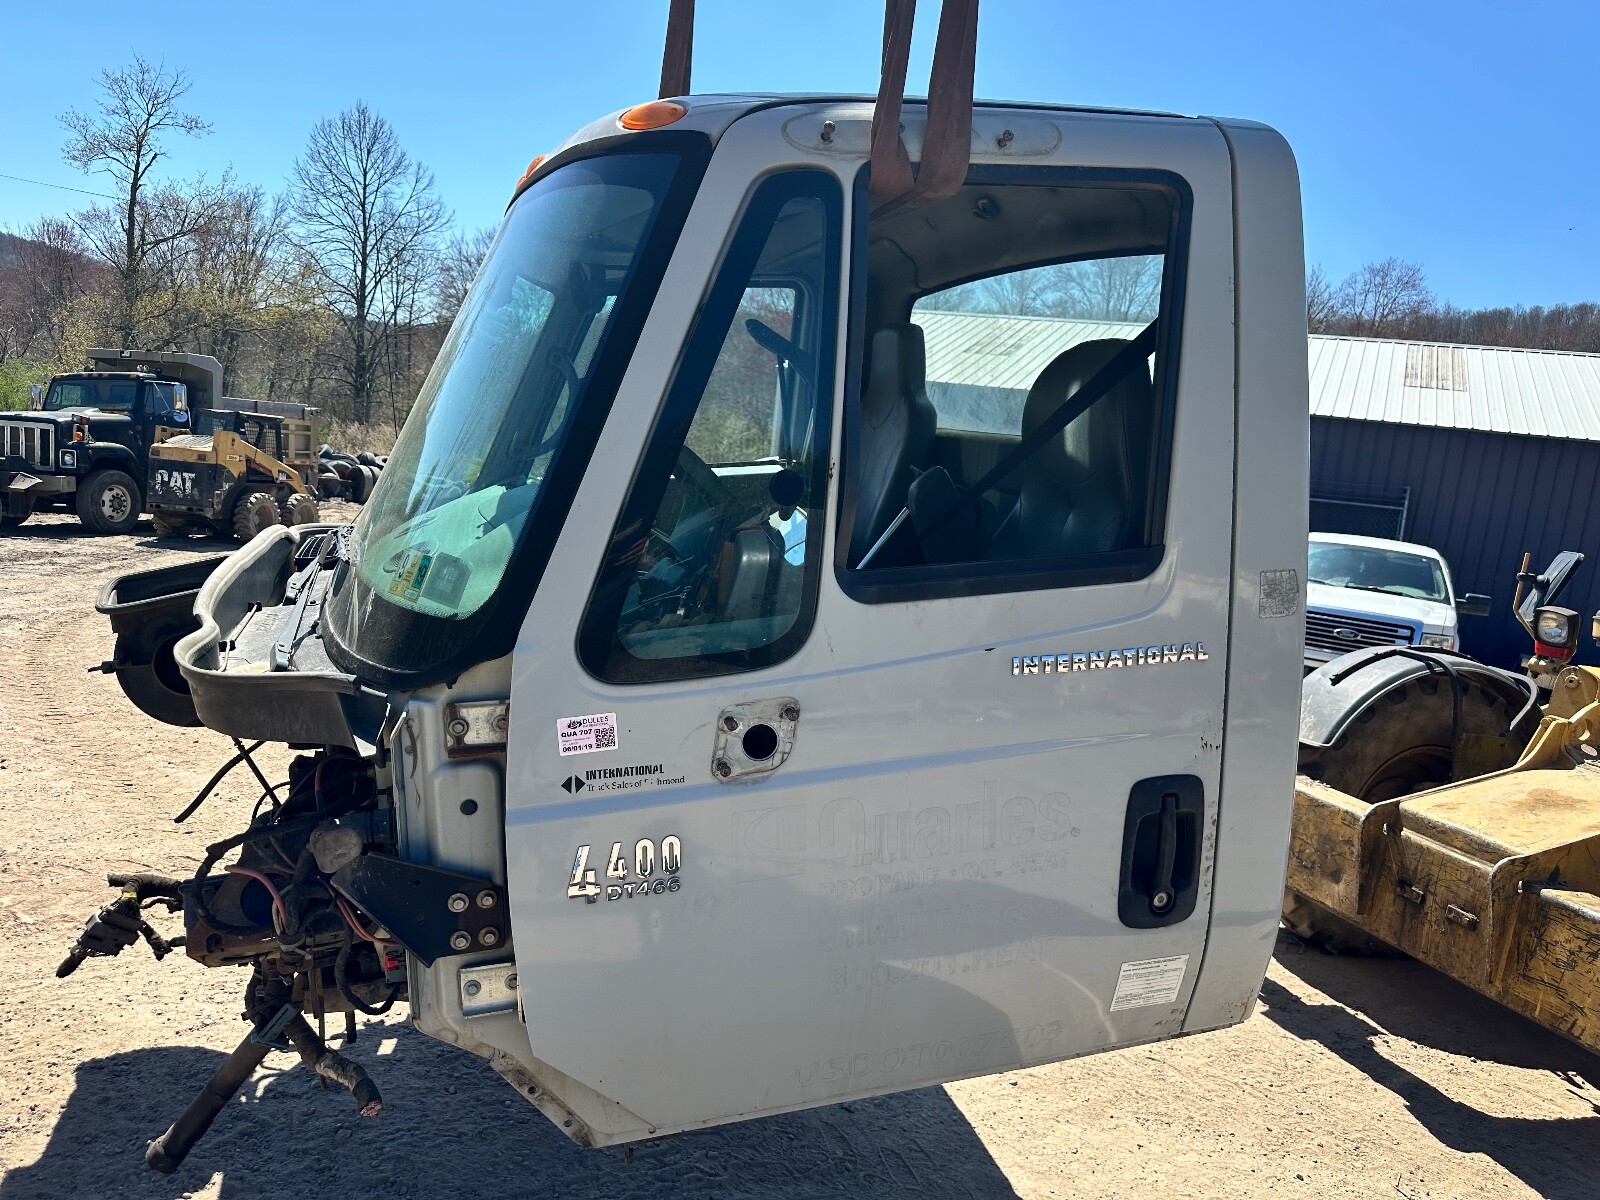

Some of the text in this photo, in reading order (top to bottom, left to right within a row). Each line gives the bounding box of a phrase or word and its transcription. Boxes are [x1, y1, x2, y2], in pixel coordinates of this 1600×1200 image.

[1011, 641, 1209, 676] INTERNATIONAL
[582, 715, 609, 725] DULLES
[561, 728, 593, 738] QUA 707
[585, 763, 665, 781] INTERNATIONAL
[567, 834, 682, 905] 4400
[606, 876, 681, 902] DT466
